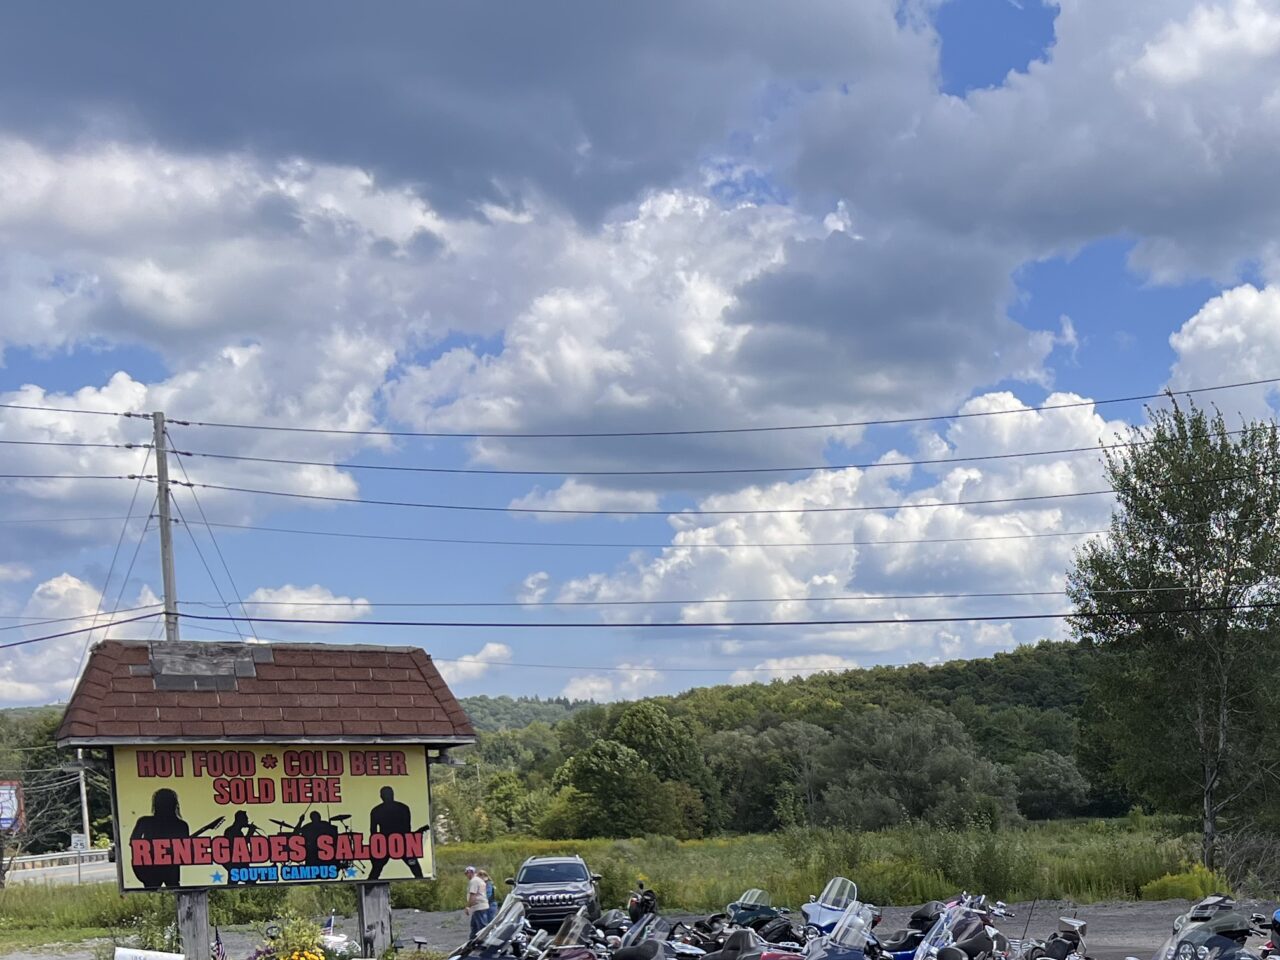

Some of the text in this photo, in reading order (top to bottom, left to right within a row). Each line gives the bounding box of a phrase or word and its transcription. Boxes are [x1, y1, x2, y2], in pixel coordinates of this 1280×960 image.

[136, 750, 409, 777] HOT FOOD COLD BEER
[213, 777, 342, 804] SOLD HERE
[131, 832, 424, 866] RENEGADES SALOON
[230, 865, 337, 882] SOUTH CAMPUS
